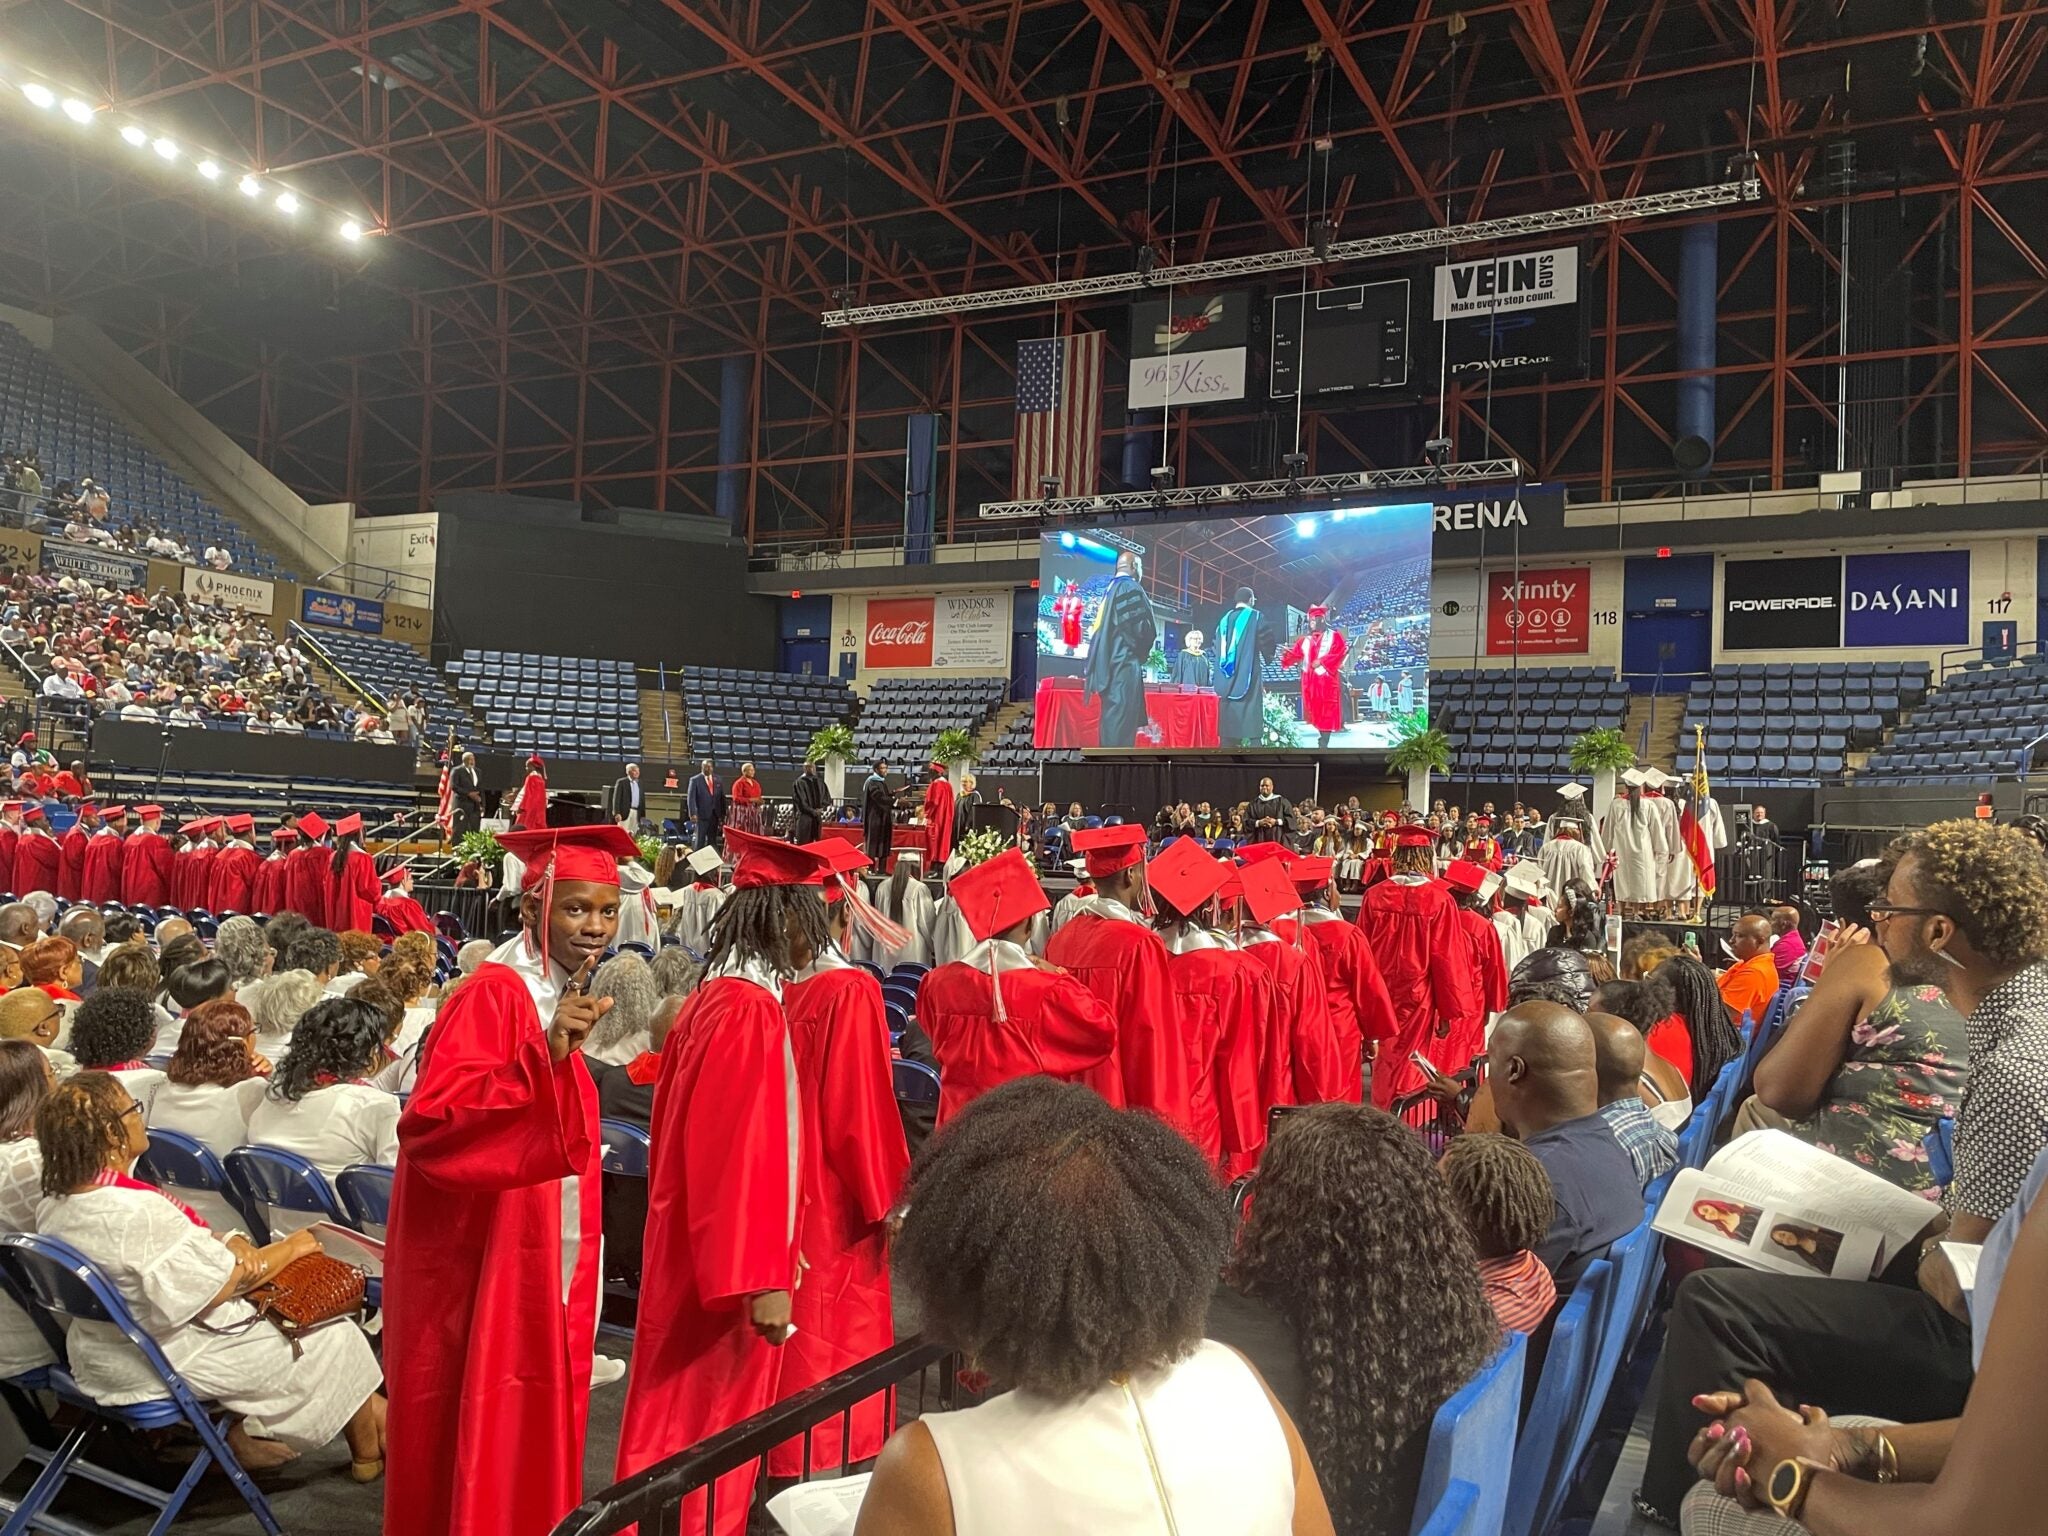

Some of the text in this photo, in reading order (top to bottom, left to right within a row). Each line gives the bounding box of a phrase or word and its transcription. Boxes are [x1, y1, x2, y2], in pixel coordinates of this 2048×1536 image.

[1450, 257, 1537, 299] VEIN
[1538, 255, 1554, 288] GUYS
[1450, 290, 1556, 312] Make every step count.
[1163, 359, 1223, 398] Kiss
[410, 532, 429, 546] Exit
[56, 555, 89, 570] WHITE
[100, 563, 132, 578] TIGER
[216, 582, 263, 600] PHOENIX
[1501, 579, 1577, 603] xfinity
[1850, 583, 1958, 615] DASANI
[947, 597, 995, 610] WINDSOR
[1987, 599, 2012, 614] 117
[393, 615, 412, 630] 121
[1593, 611, 1617, 626] 118
[841, 635, 857, 647] 120
[868, 621, 931, 646] Coca-Cola
